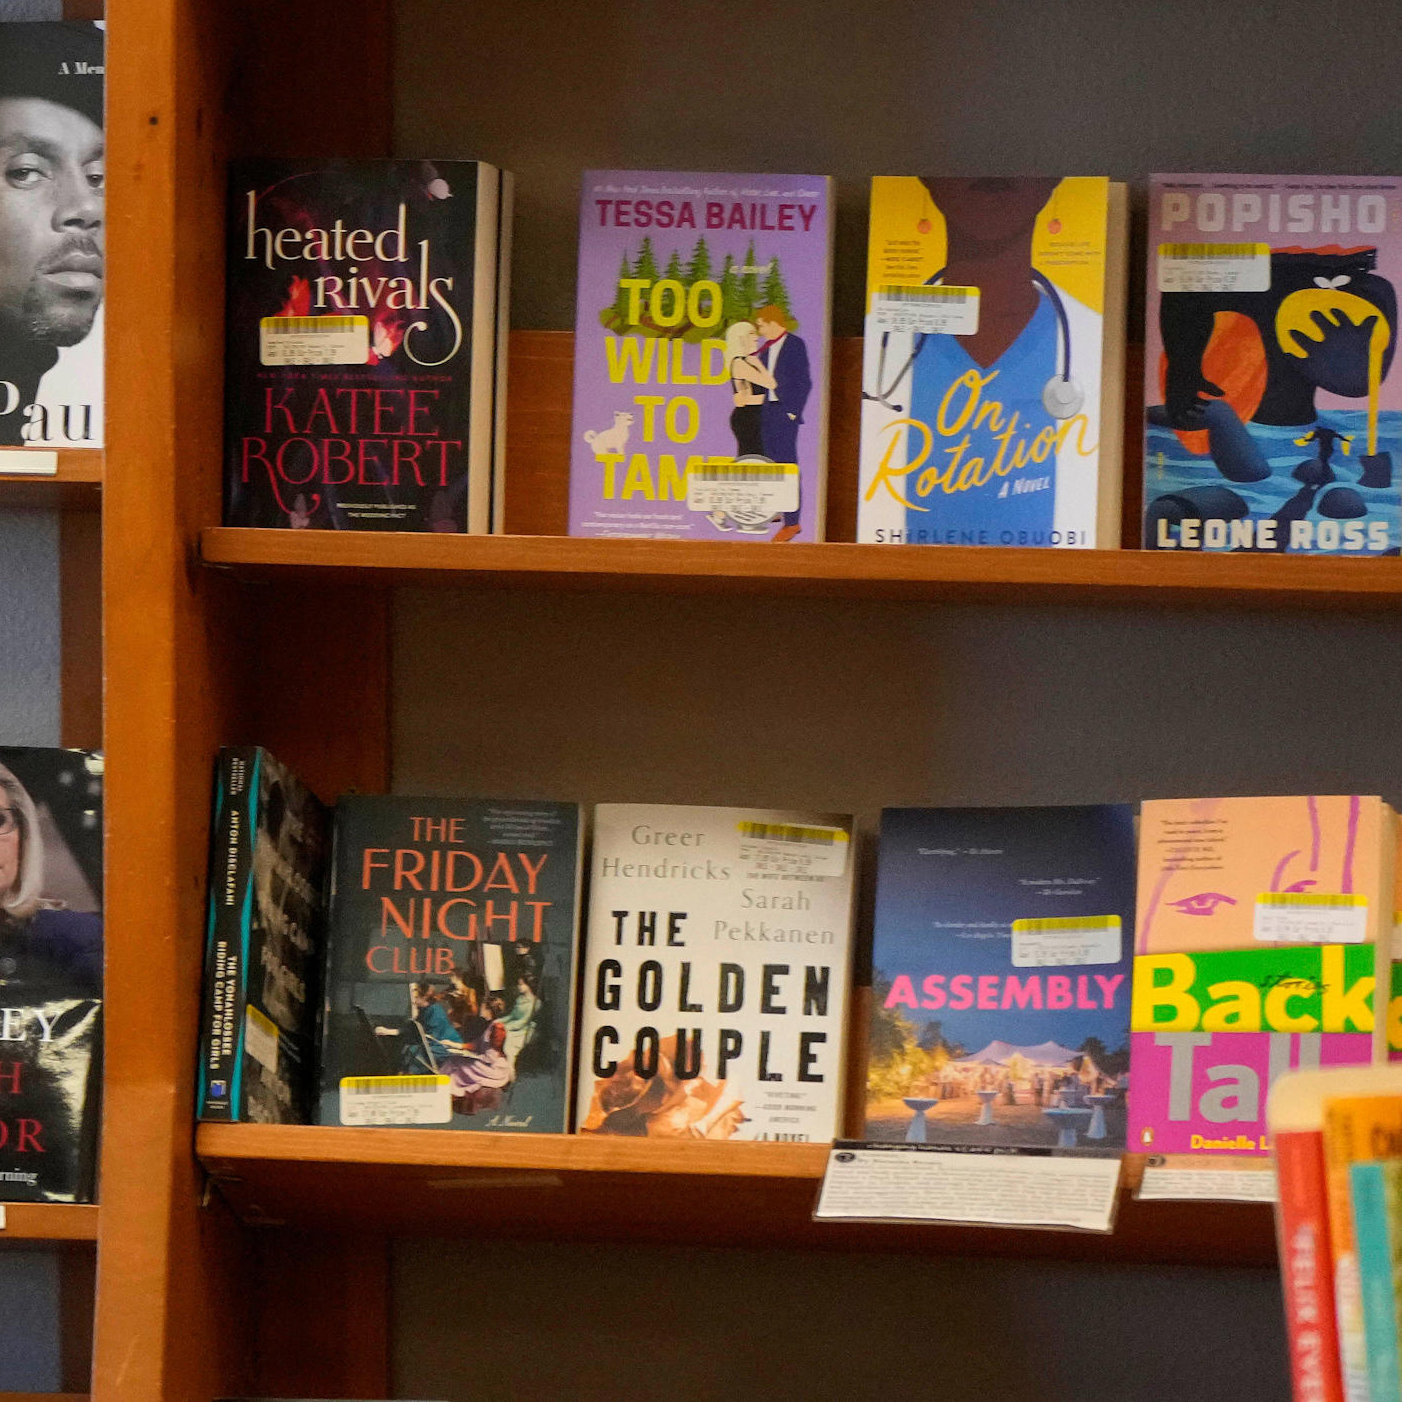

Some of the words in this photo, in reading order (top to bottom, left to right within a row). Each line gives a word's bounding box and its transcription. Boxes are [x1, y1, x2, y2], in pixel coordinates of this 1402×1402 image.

[244, 191, 408, 270] heated
[596, 200, 696, 230] TESSA
[706, 201, 818, 232] BAILEY
[1159, 193, 1387, 233] POPISHO
[1158, 519, 1278, 549] LEONE
[1290, 521, 1389, 550] ROSS
[362, 847, 548, 894] FRIDAY
[380, 898, 553, 943] NIGHT
[595, 959, 830, 1017] GOLDEN
[884, 974, 1125, 1011] ASSEMBLY
[1133, 945, 1376, 1033] Back
[593, 1024, 827, 1083] COUPLE
